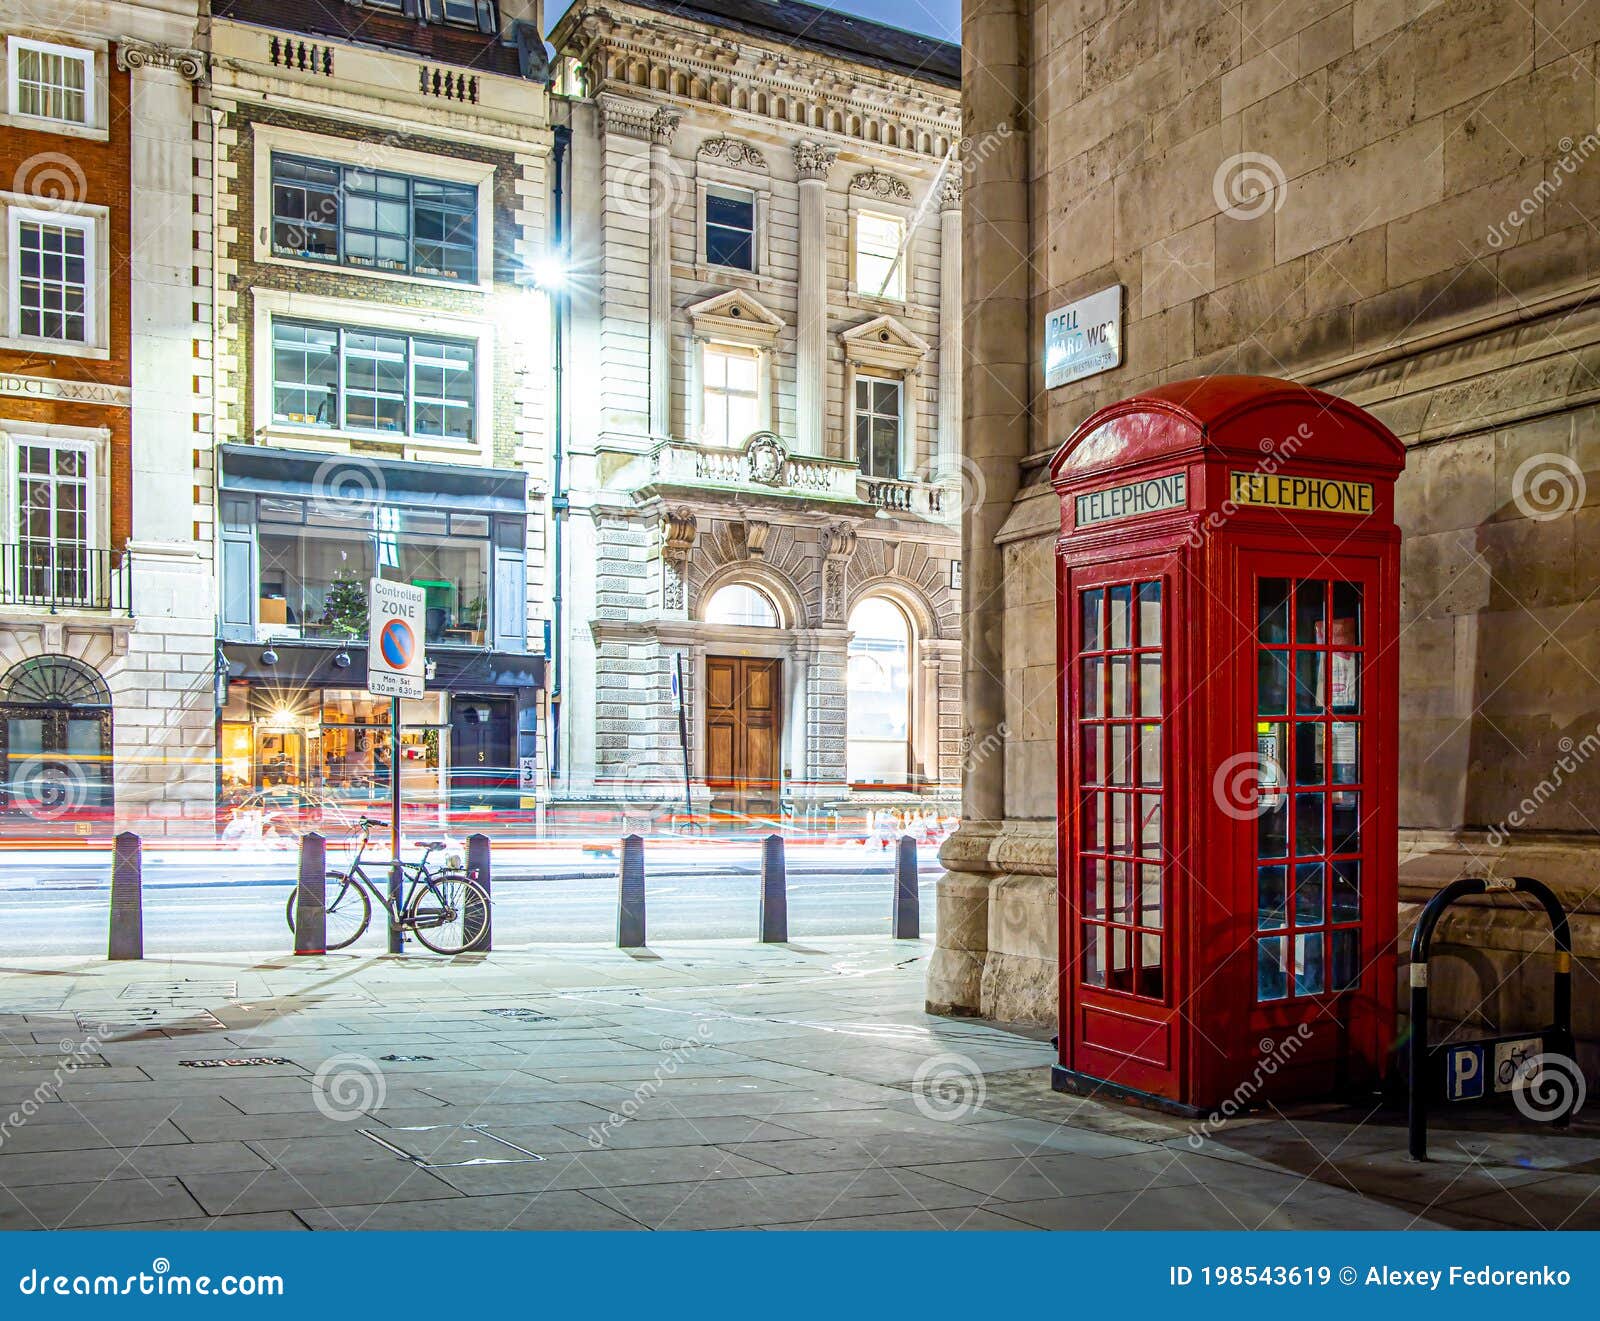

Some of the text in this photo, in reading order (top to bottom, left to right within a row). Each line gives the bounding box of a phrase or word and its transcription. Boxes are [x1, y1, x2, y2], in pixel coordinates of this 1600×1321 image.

[1052, 310, 1078, 338] BELL
[1078, 473, 1185, 523] TELEPHONE
[1231, 472, 1370, 512] TELEPHONE
[375, 583, 421, 602] Controlled
[382, 600, 415, 618] ZONE
[383, 675, 410, 685] Mon Sat
[478, 751, 485, 762] 3
[524, 766, 532, 782] 3
[1455, 1050, 1479, 1097] P
